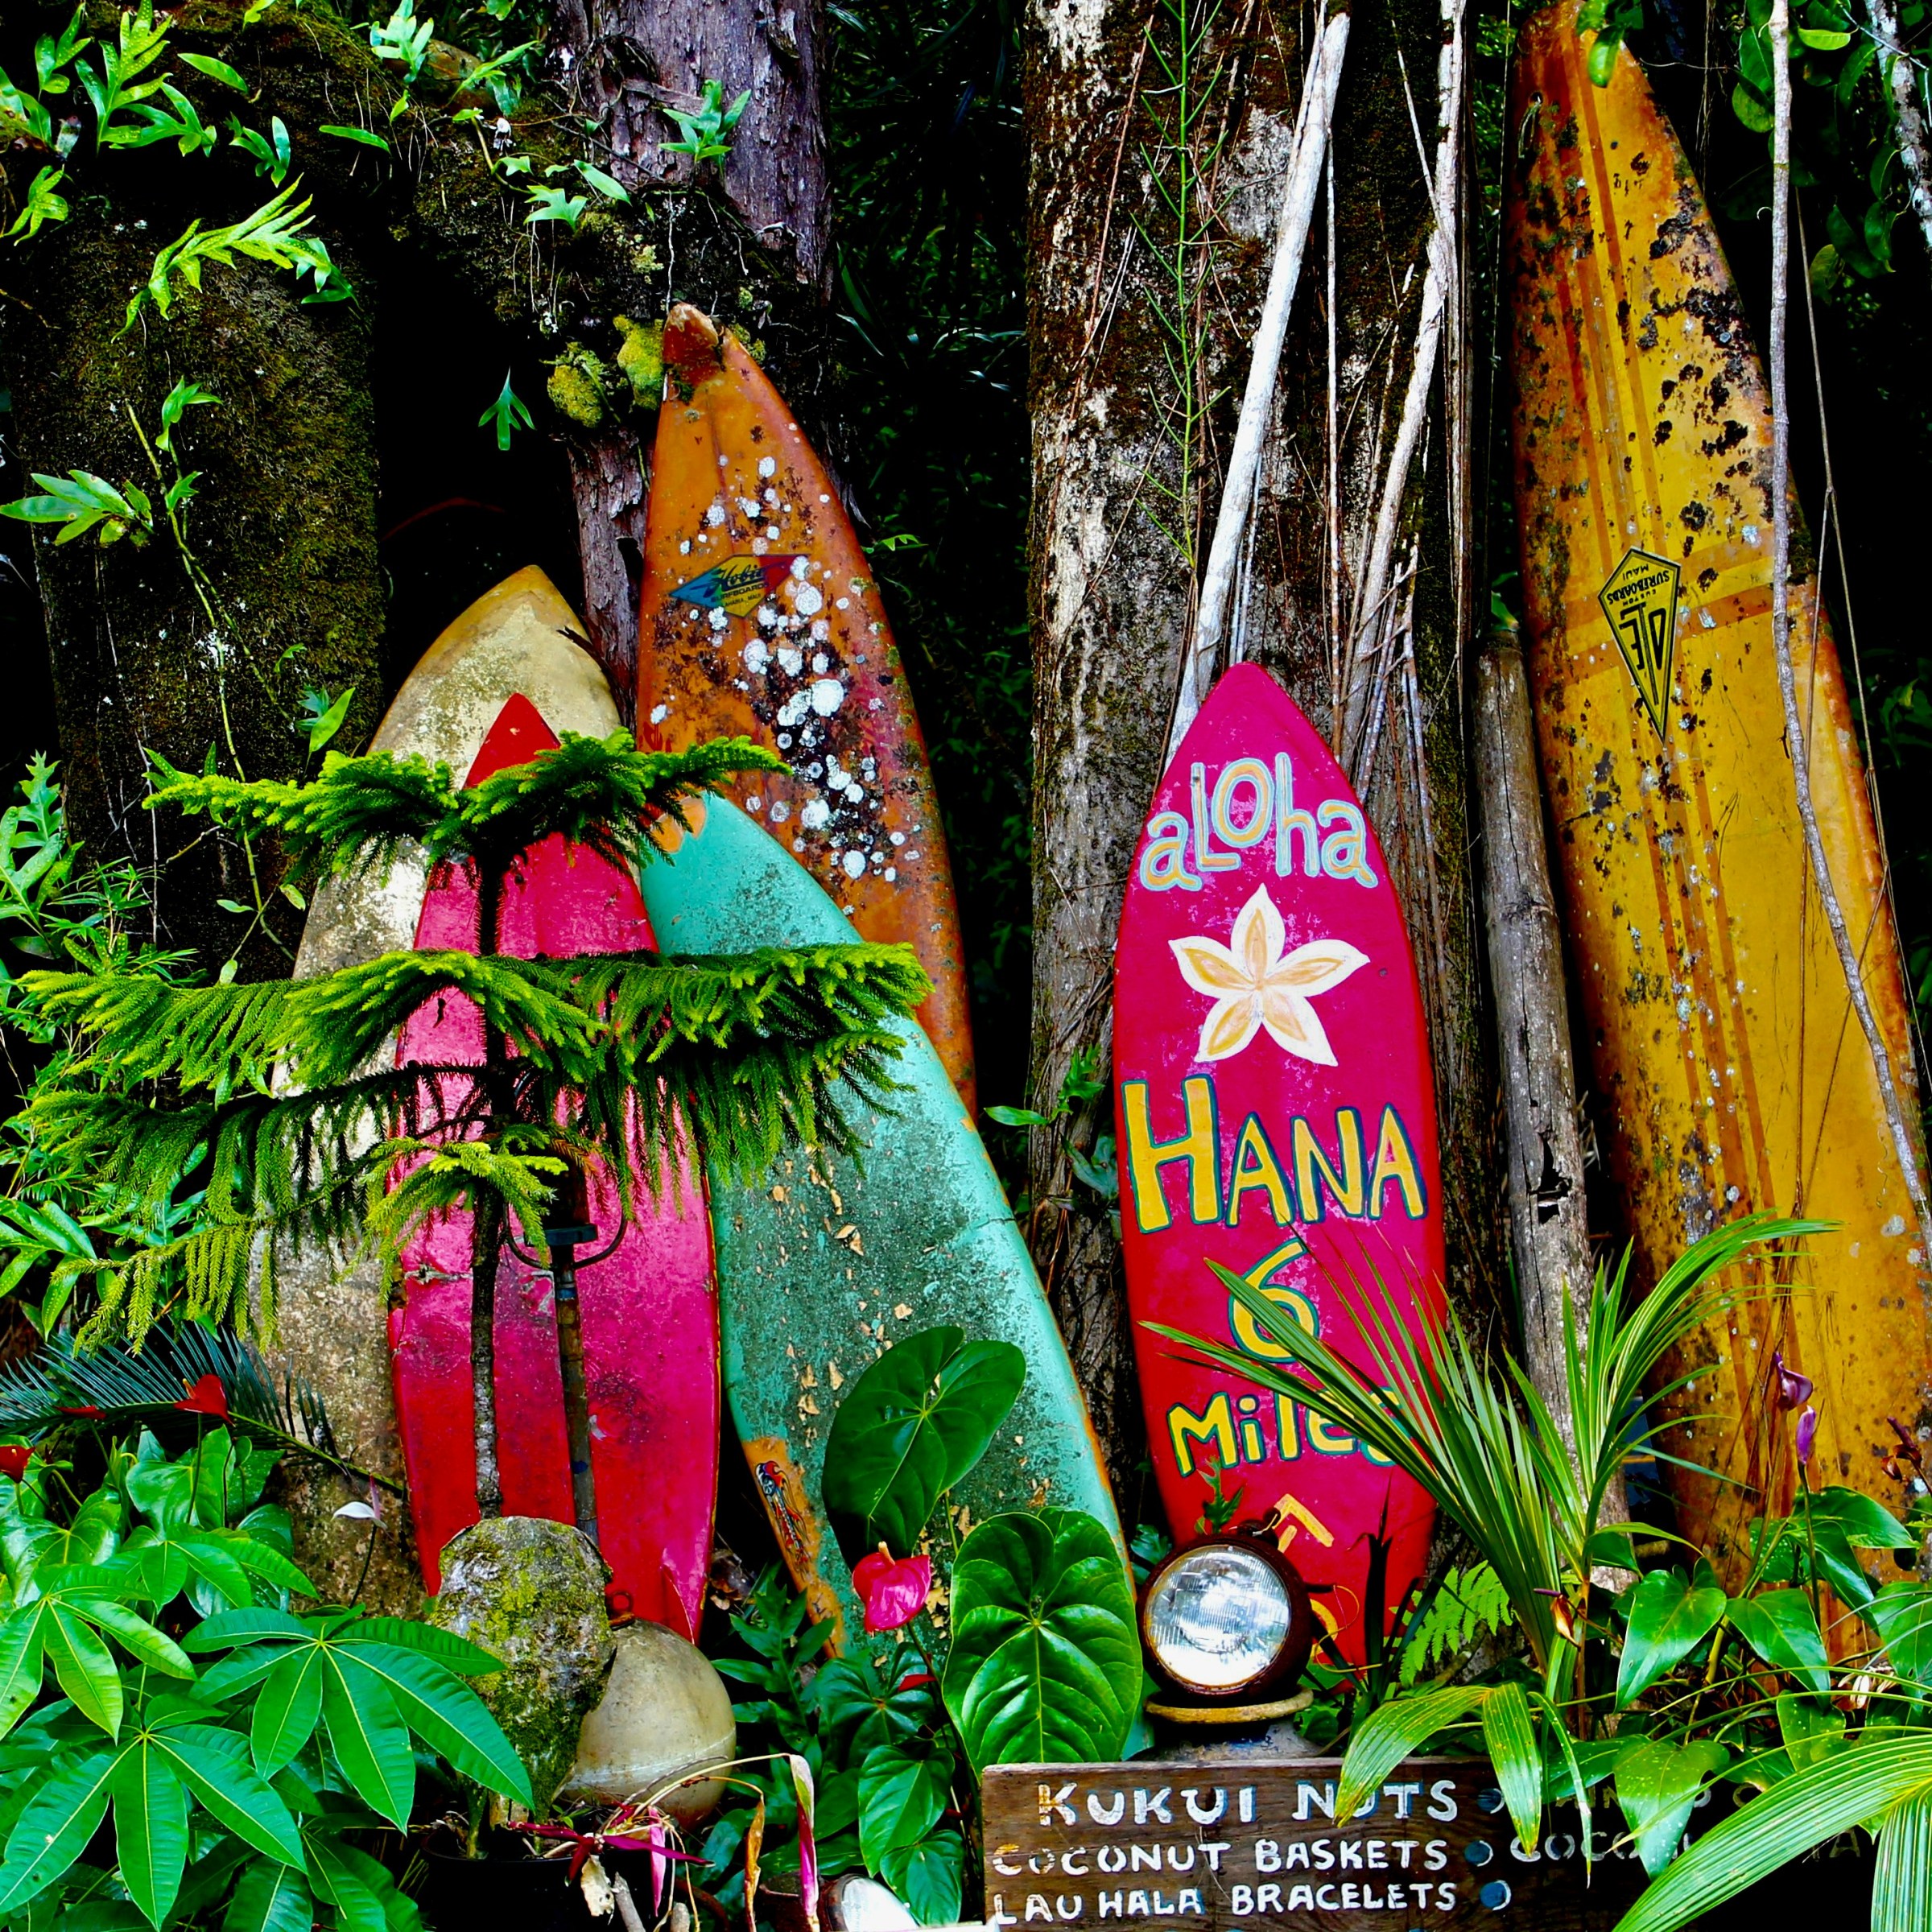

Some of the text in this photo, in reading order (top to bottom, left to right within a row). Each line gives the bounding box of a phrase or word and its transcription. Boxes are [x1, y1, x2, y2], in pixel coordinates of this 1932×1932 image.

[1606, 570, 1670, 605] SURFBOARDS
[1623, 564, 1649, 581] MAUI
[1622, 589, 1657, 606] CUSTOM
[1121, 1073, 1427, 1234] HANA
[1228, 1237, 1319, 1363] 6
[1037, 1780, 1258, 1827] KUKUI
[993, 1838, 1448, 1876] COCONUT BASKETS
[993, 1881, 1458, 1925] LAU HALA BRACELETS
